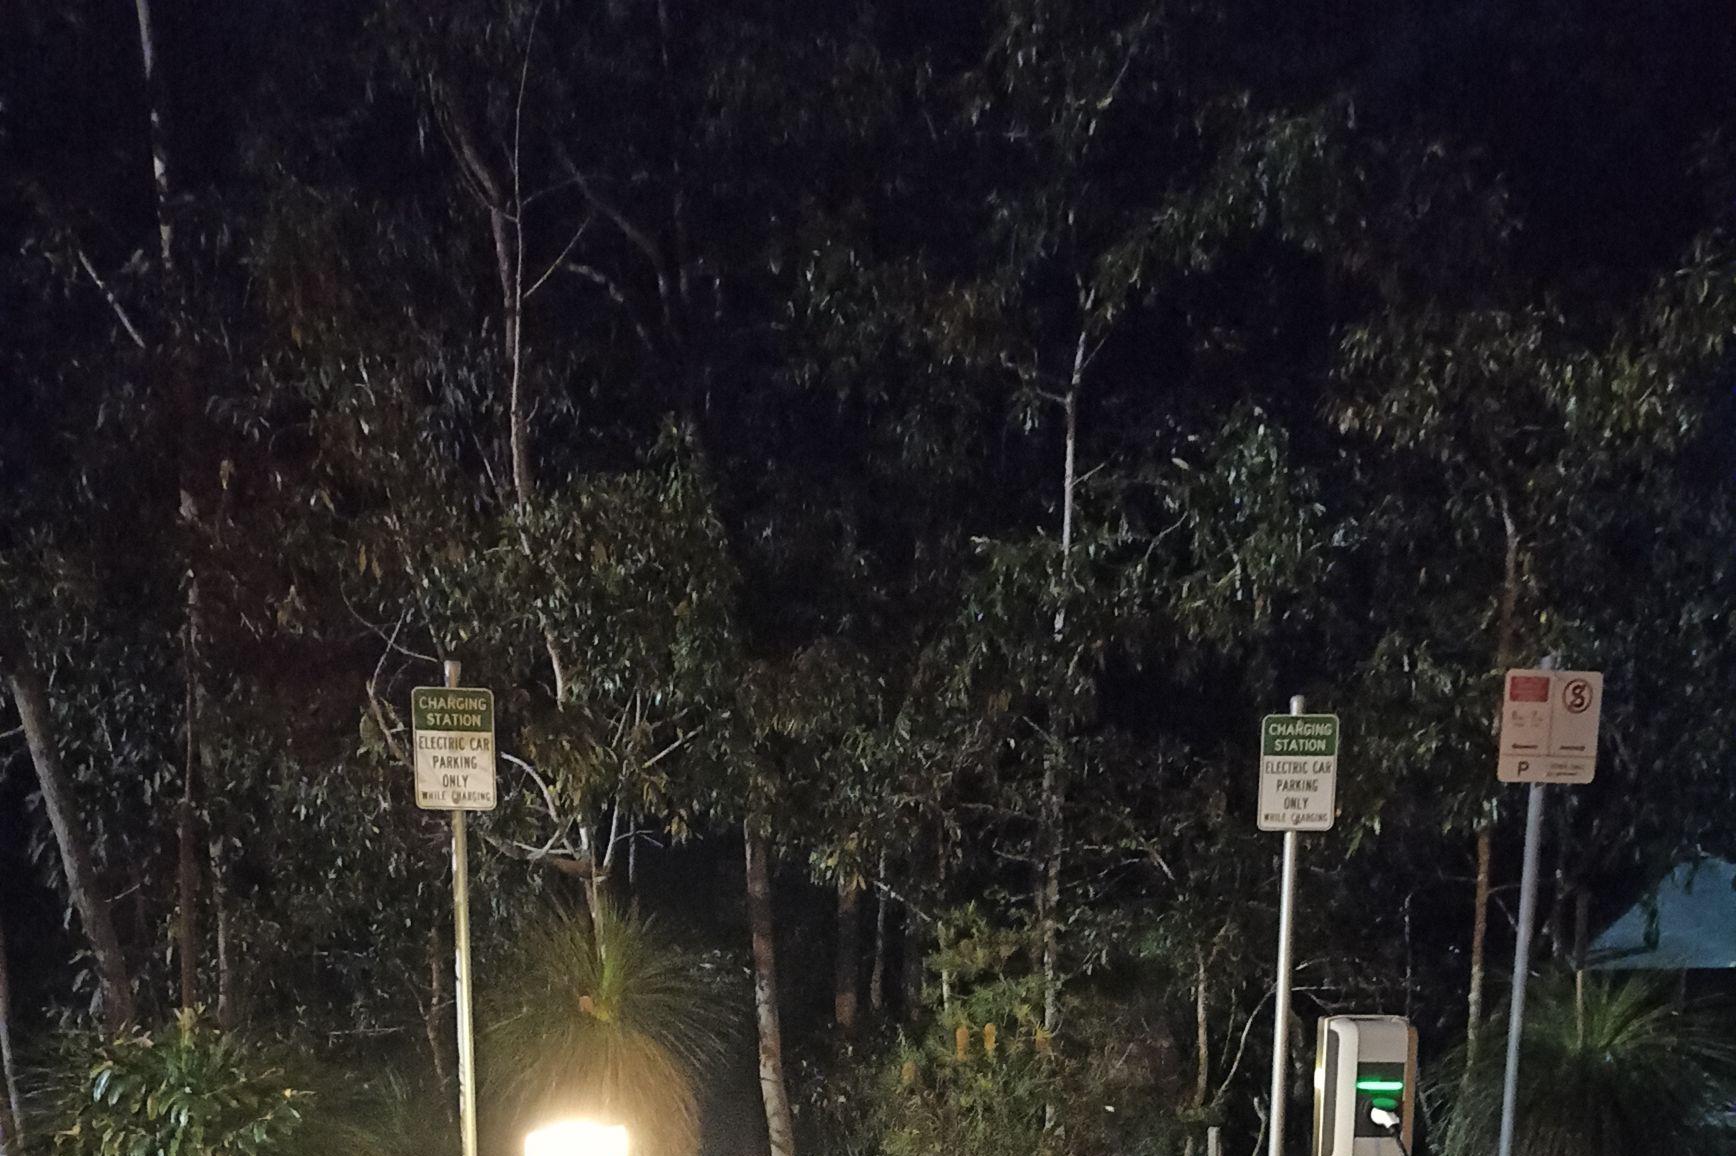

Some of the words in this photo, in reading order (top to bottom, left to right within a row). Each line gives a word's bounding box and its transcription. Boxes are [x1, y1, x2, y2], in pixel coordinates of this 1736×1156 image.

[419, 696, 487, 710] CHARGING
[426, 713, 482, 727] STATION
[1268, 723, 1333, 736] CHARGING
[418, 736, 465, 751] ELECTRIC
[469, 737, 490, 752] CAR
[1274, 739, 1326, 752] STATION
[432, 755, 478, 769] PARKING
[1265, 760, 1308, 774] ELECTRIC
[1312, 760, 1332, 774] CAR
[442, 774, 469, 788] ONLY
[1276, 779, 1319, 792] PARKING
[421, 791, 446, 801] WHILE
[452, 791, 491, 802] CHARGING
[1283, 796, 1309, 810] ONLY
